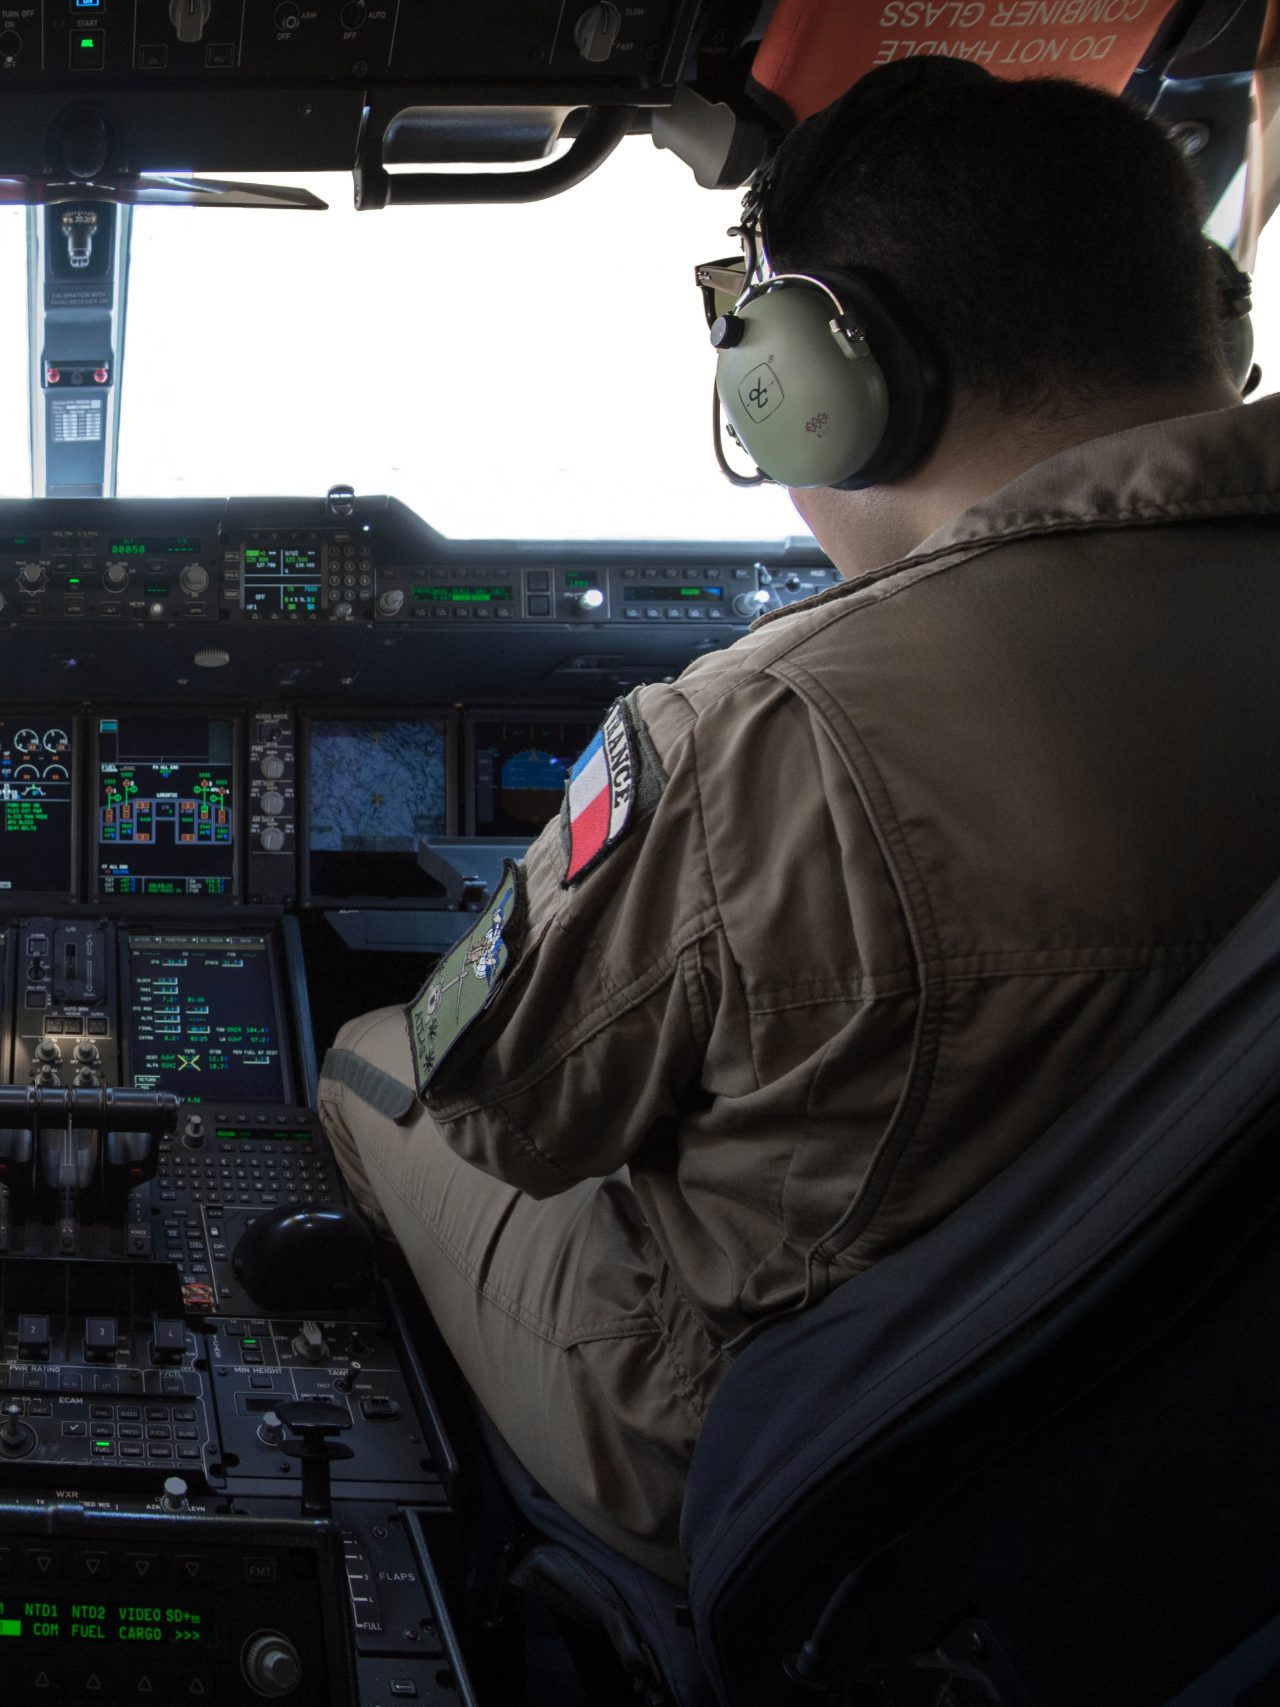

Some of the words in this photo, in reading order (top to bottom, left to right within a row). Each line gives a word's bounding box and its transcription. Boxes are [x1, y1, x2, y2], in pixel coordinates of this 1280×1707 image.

[1, 11, 20, 19] TURN
[22, 9, 36, 18] OFF
[368, 11, 386, 20] AUTO
[879, 1, 985, 28] GLASS
[990, 0, 1149, 27] COMBINER
[4, 21, 15, 29] ON
[76, 19, 98, 27] START
[277, 33, 291, 41] OFF
[343, 32, 358, 40] OFF
[1007, 36, 1068, 65] NOT
[1070, 34, 1117, 61] DO
[30, 1366, 61, 1374] RATING
[55, 1491, 79, 1499] WXR
[378, 1572, 417, 1581] FLAPS
[24, 1602, 59, 1617] NTD1
[71, 1604, 106, 1620] NTD2
[118, 1607, 162, 1621] VIDEO
[363, 1622, 383, 1632] FULL
[32, 1623, 60, 1637] COM
[71, 1624, 106, 1639] FUEL
[118, 1625, 162, 1641] CARGO
